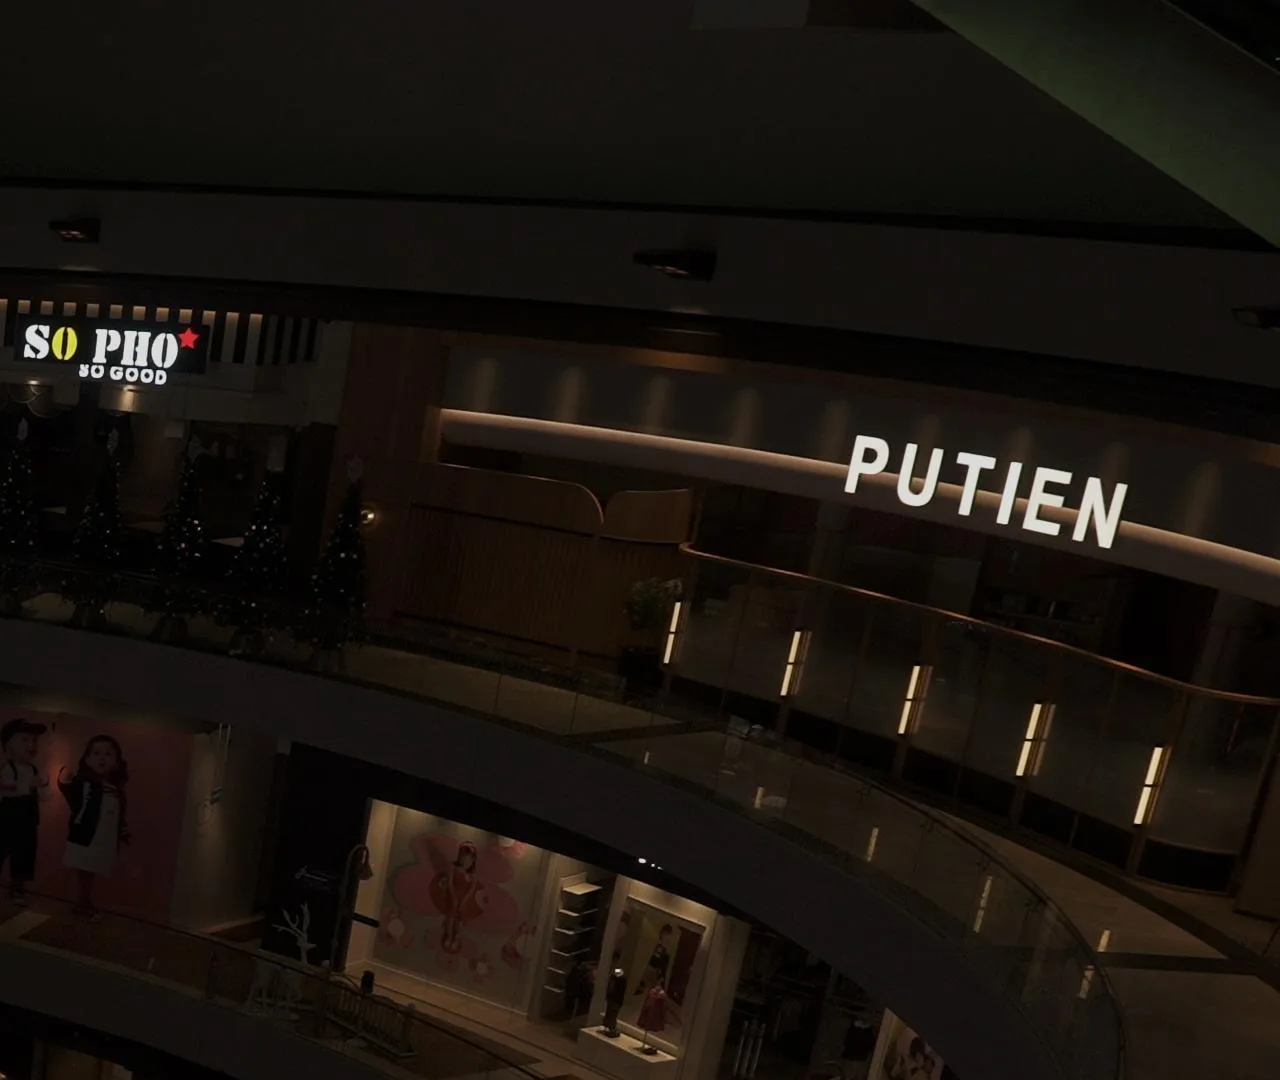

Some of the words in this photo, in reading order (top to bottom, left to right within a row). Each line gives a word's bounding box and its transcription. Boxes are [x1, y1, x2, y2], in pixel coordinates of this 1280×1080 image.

[23, 324, 79, 361] SO
[92, 327, 180, 369] PHO
[78, 363, 106, 379] SO
[109, 365, 168, 386] GOOD
[843, 434, 1129, 550] PUTIEN
